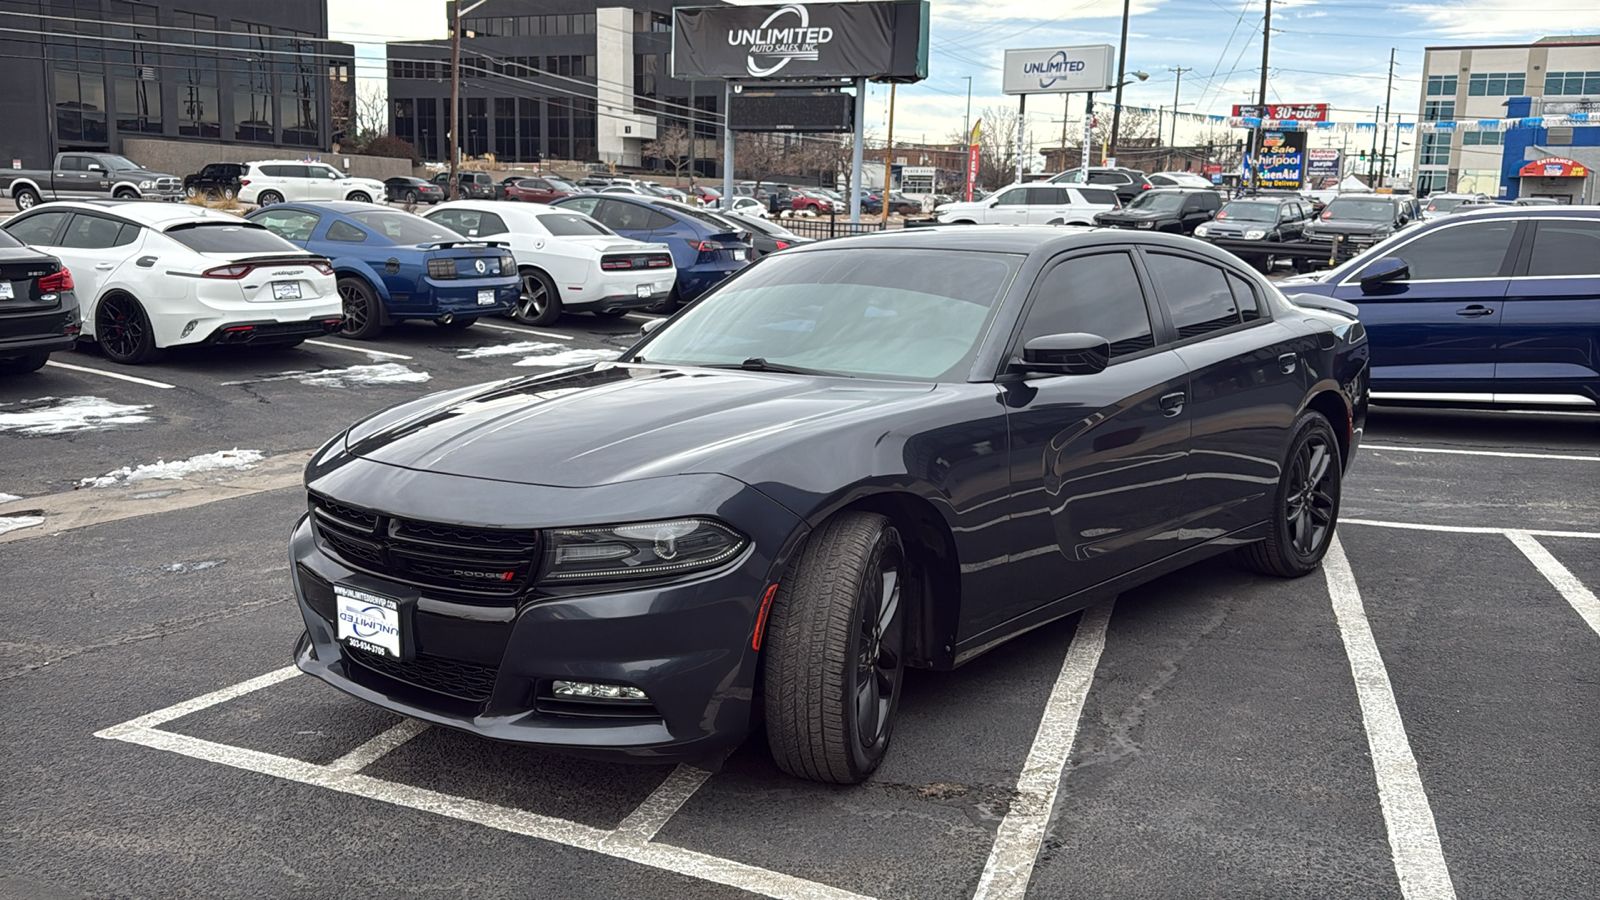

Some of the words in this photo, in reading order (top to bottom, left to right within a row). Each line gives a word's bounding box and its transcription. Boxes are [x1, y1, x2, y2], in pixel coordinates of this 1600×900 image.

[728, 27, 833, 46] UNLIMITED
[1024, 61, 1085, 74] UNLIMITED
[1270, 146, 1296, 154] Sale
[1536, 157, 1574, 166] ENTRANCE
[1244, 169, 1299, 179] KchenAid
[453, 569, 505, 579] DODGE
[339, 612, 399, 636] UNLIMITED
[349, 638, 385, 656] 303-934-3705
